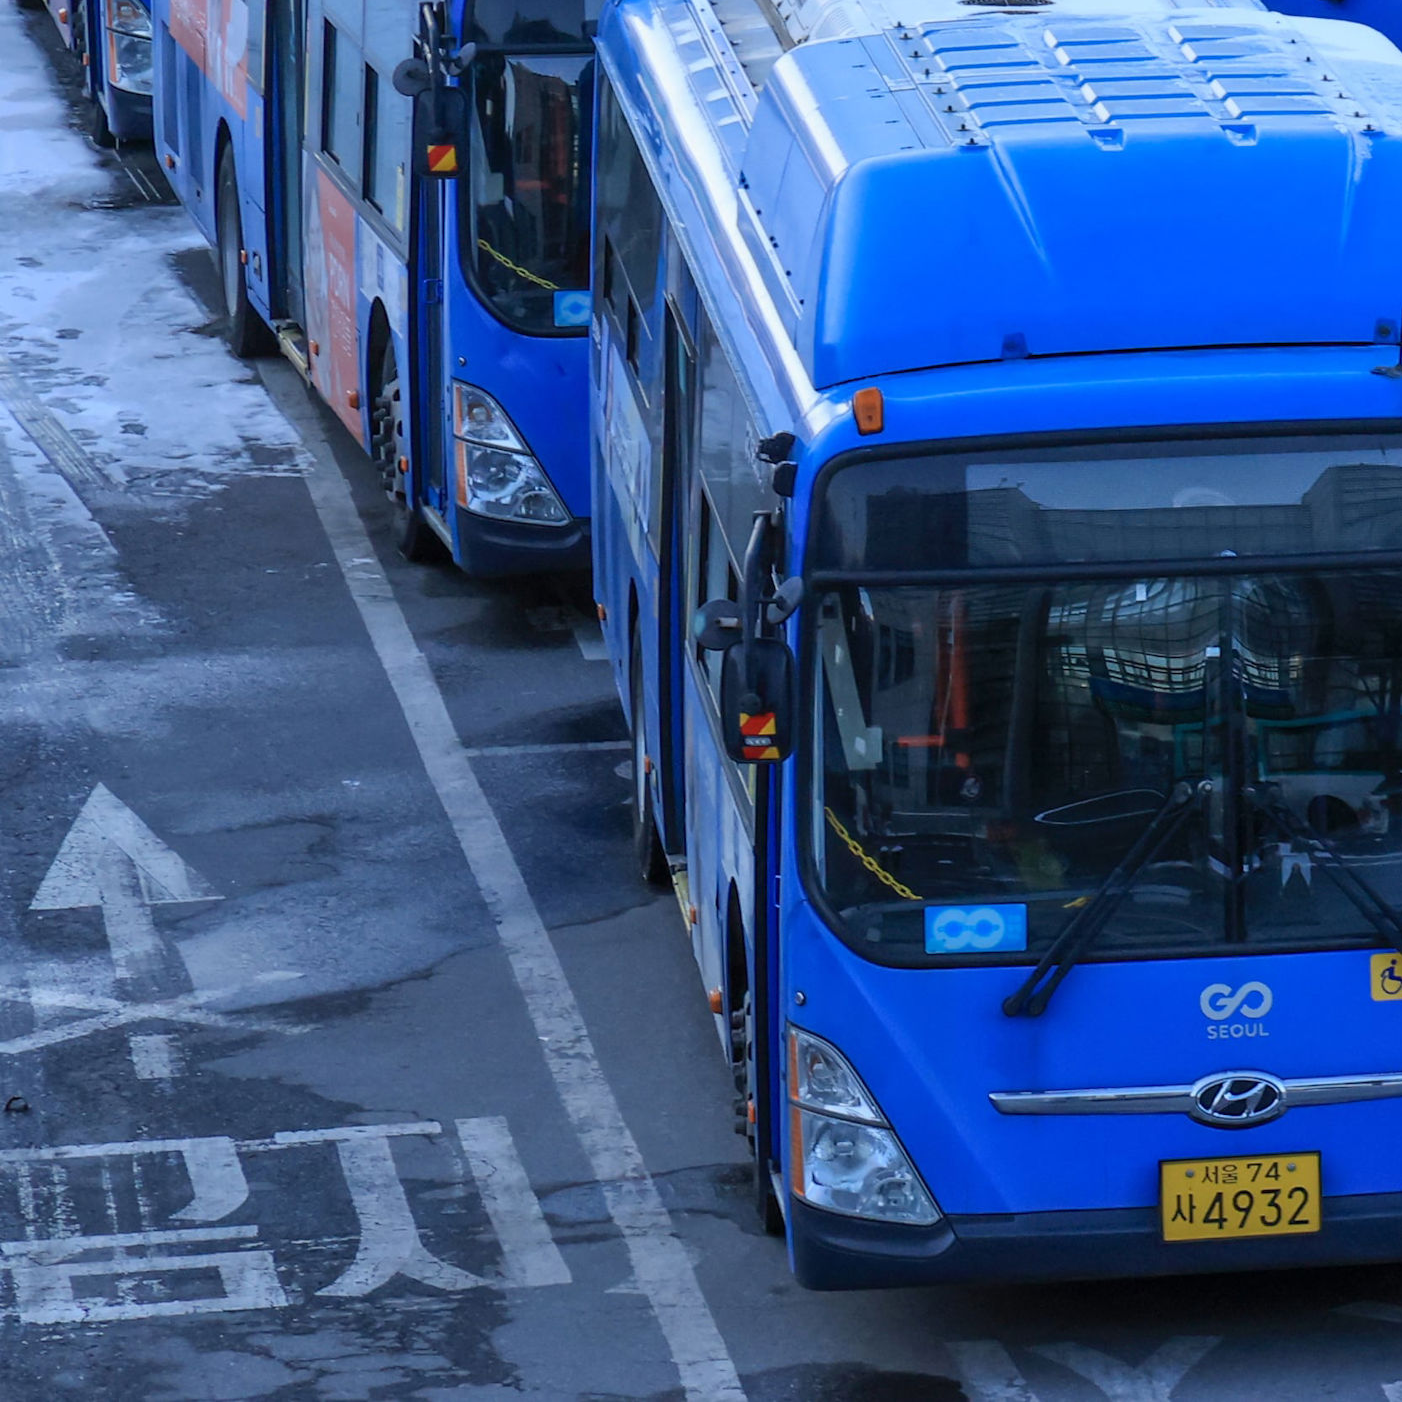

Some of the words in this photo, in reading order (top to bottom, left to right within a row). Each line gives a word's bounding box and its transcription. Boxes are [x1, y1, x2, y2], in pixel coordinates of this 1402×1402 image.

[1200, 981, 1273, 1021] GO
[1207, 1023, 1270, 1040] SEOUL
[1201, 1164, 1238, 1184] 서울
[1246, 1162, 1281, 1183] 74
[1171, 1186, 1309, 1230] 사4932
